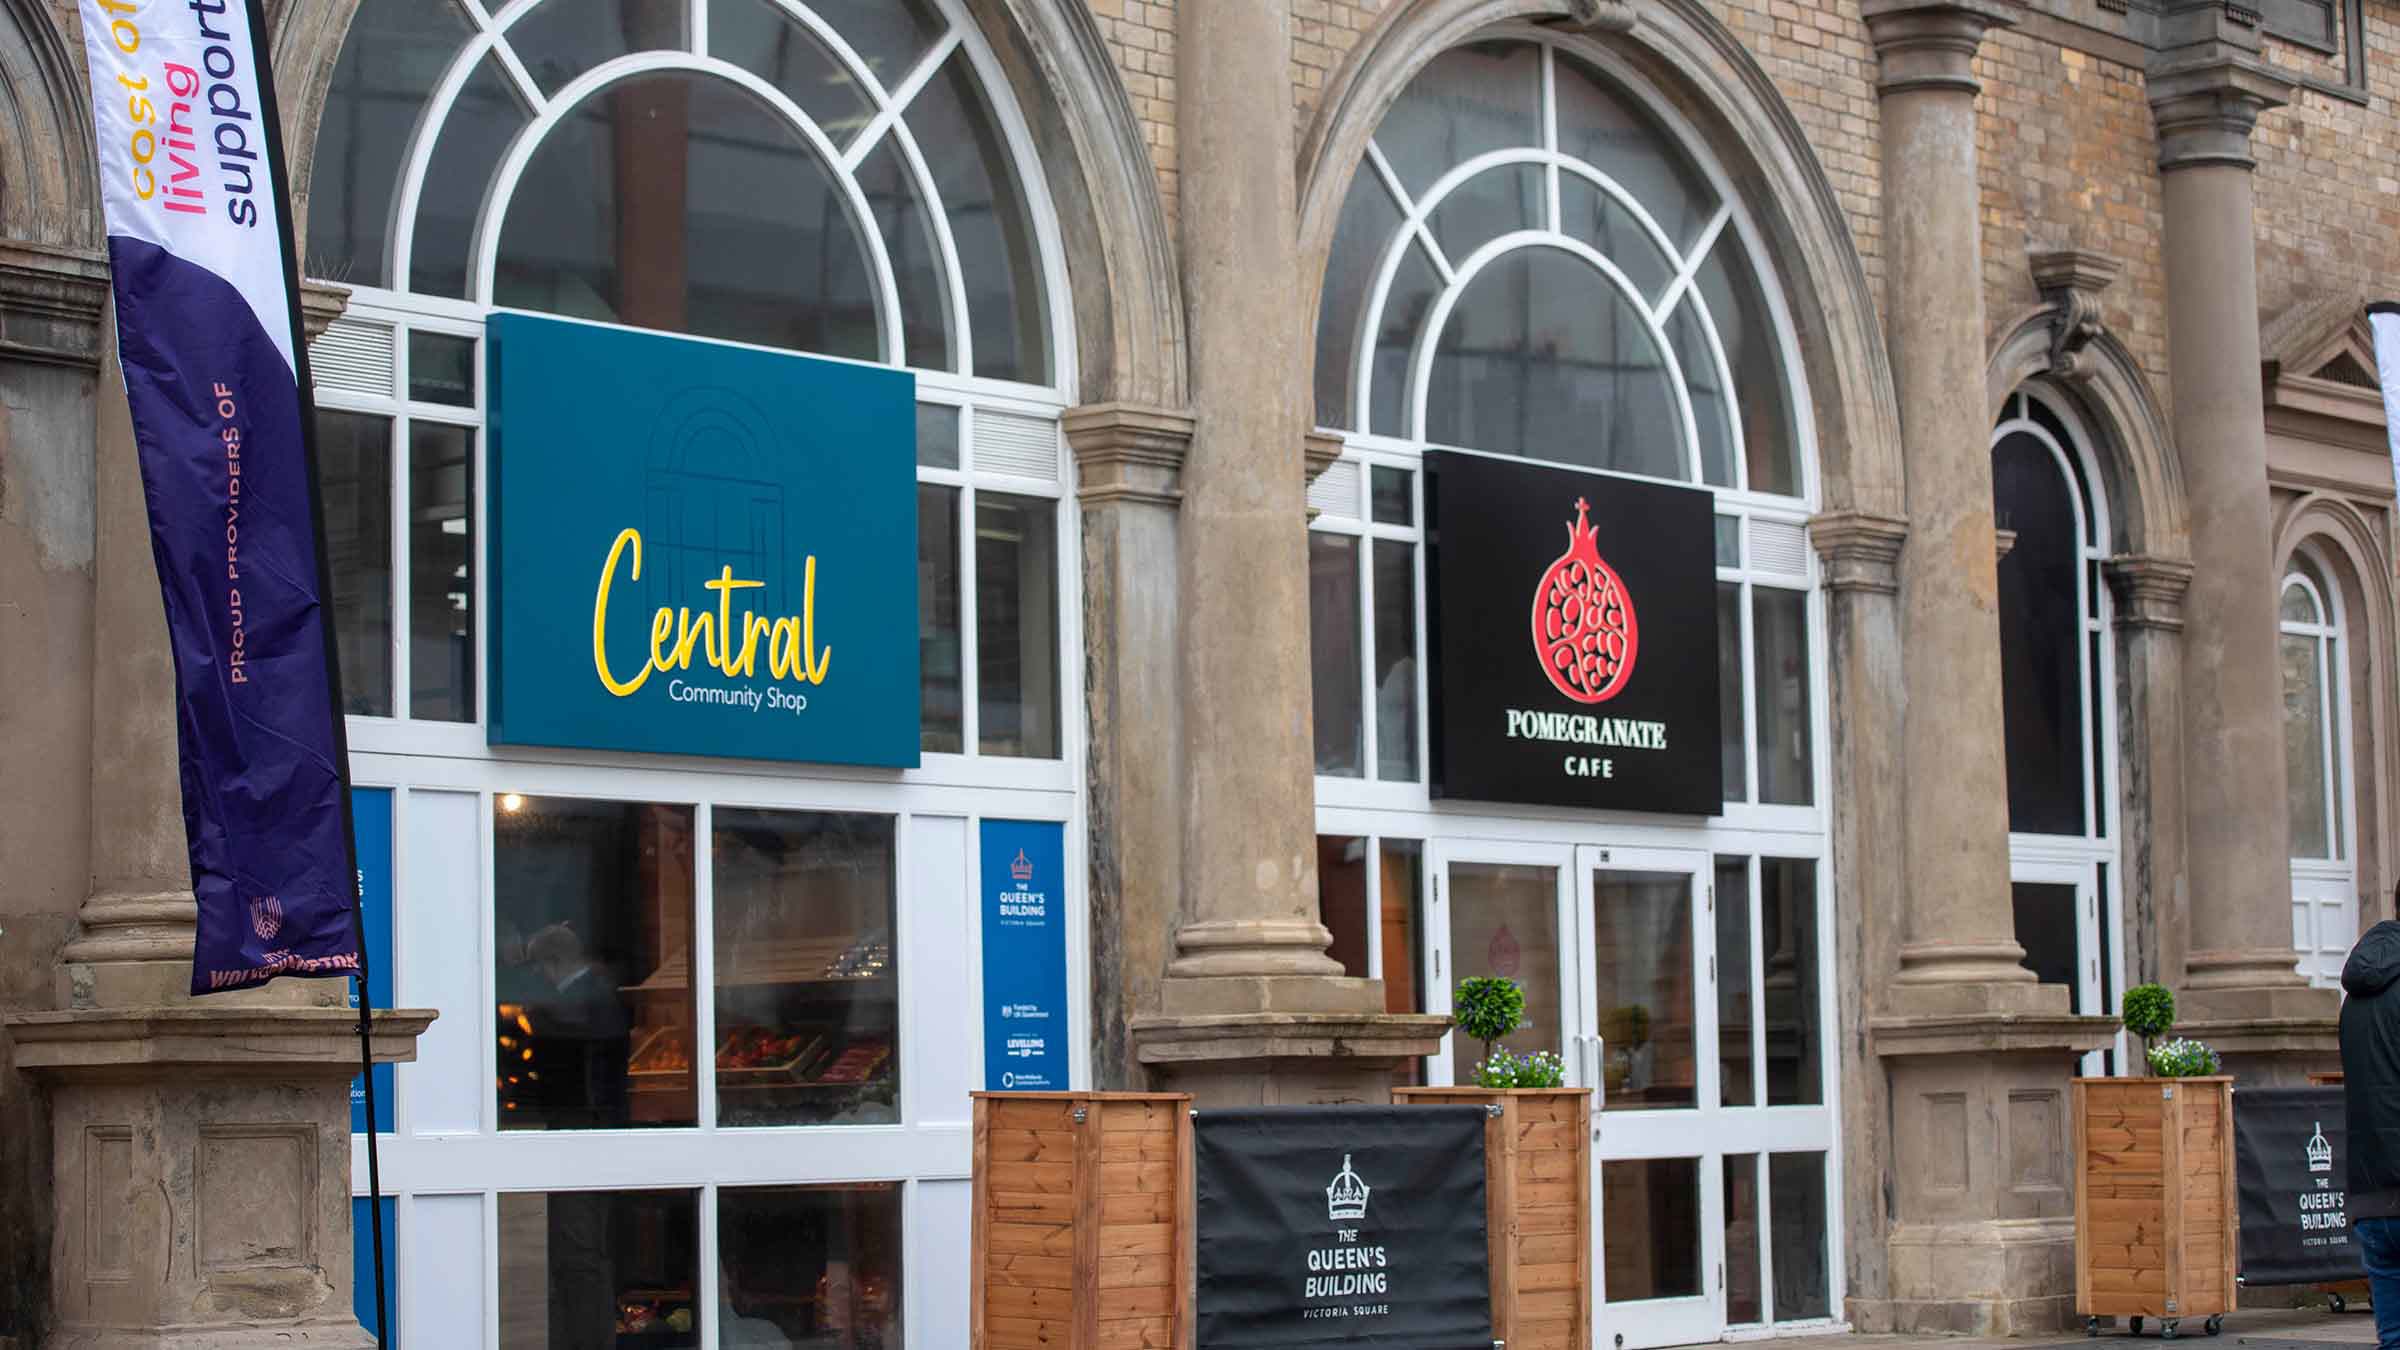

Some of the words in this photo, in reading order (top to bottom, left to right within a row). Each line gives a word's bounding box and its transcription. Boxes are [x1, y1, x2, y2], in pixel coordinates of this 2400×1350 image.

[97, 0, 141, 54] of
[189, 0, 258, 228] support
[117, 72, 156, 200] cost
[162, 62, 207, 214] living
[213, 383, 236, 419] OF
[223, 427, 241, 580] PROVIDERS
[593, 528, 831, 697] Central
[230, 588, 248, 684] PROUD
[669, 679, 762, 712] Community
[767, 686, 808, 716] Shop
[1506, 709, 1667, 750] POMEGRANATE
[1564, 756, 1613, 778] CAFE
[1000, 891, 1045, 904] QUEEN'S
[1000, 904, 1046, 917] BUILDING
[2315, 1178, 2328, 1188] THE
[2299, 1192, 2344, 1210] QUEEN'S
[1337, 1229, 1358, 1243] THE
[2300, 1212, 2347, 1230] BUILDING
[1307, 1246, 1386, 1271] QUEEN'S
[1305, 1272, 1387, 1298] BUILDING
[1303, 1307, 1348, 1319] VICTORIA
[1353, 1304, 1389, 1316] SQUARE
